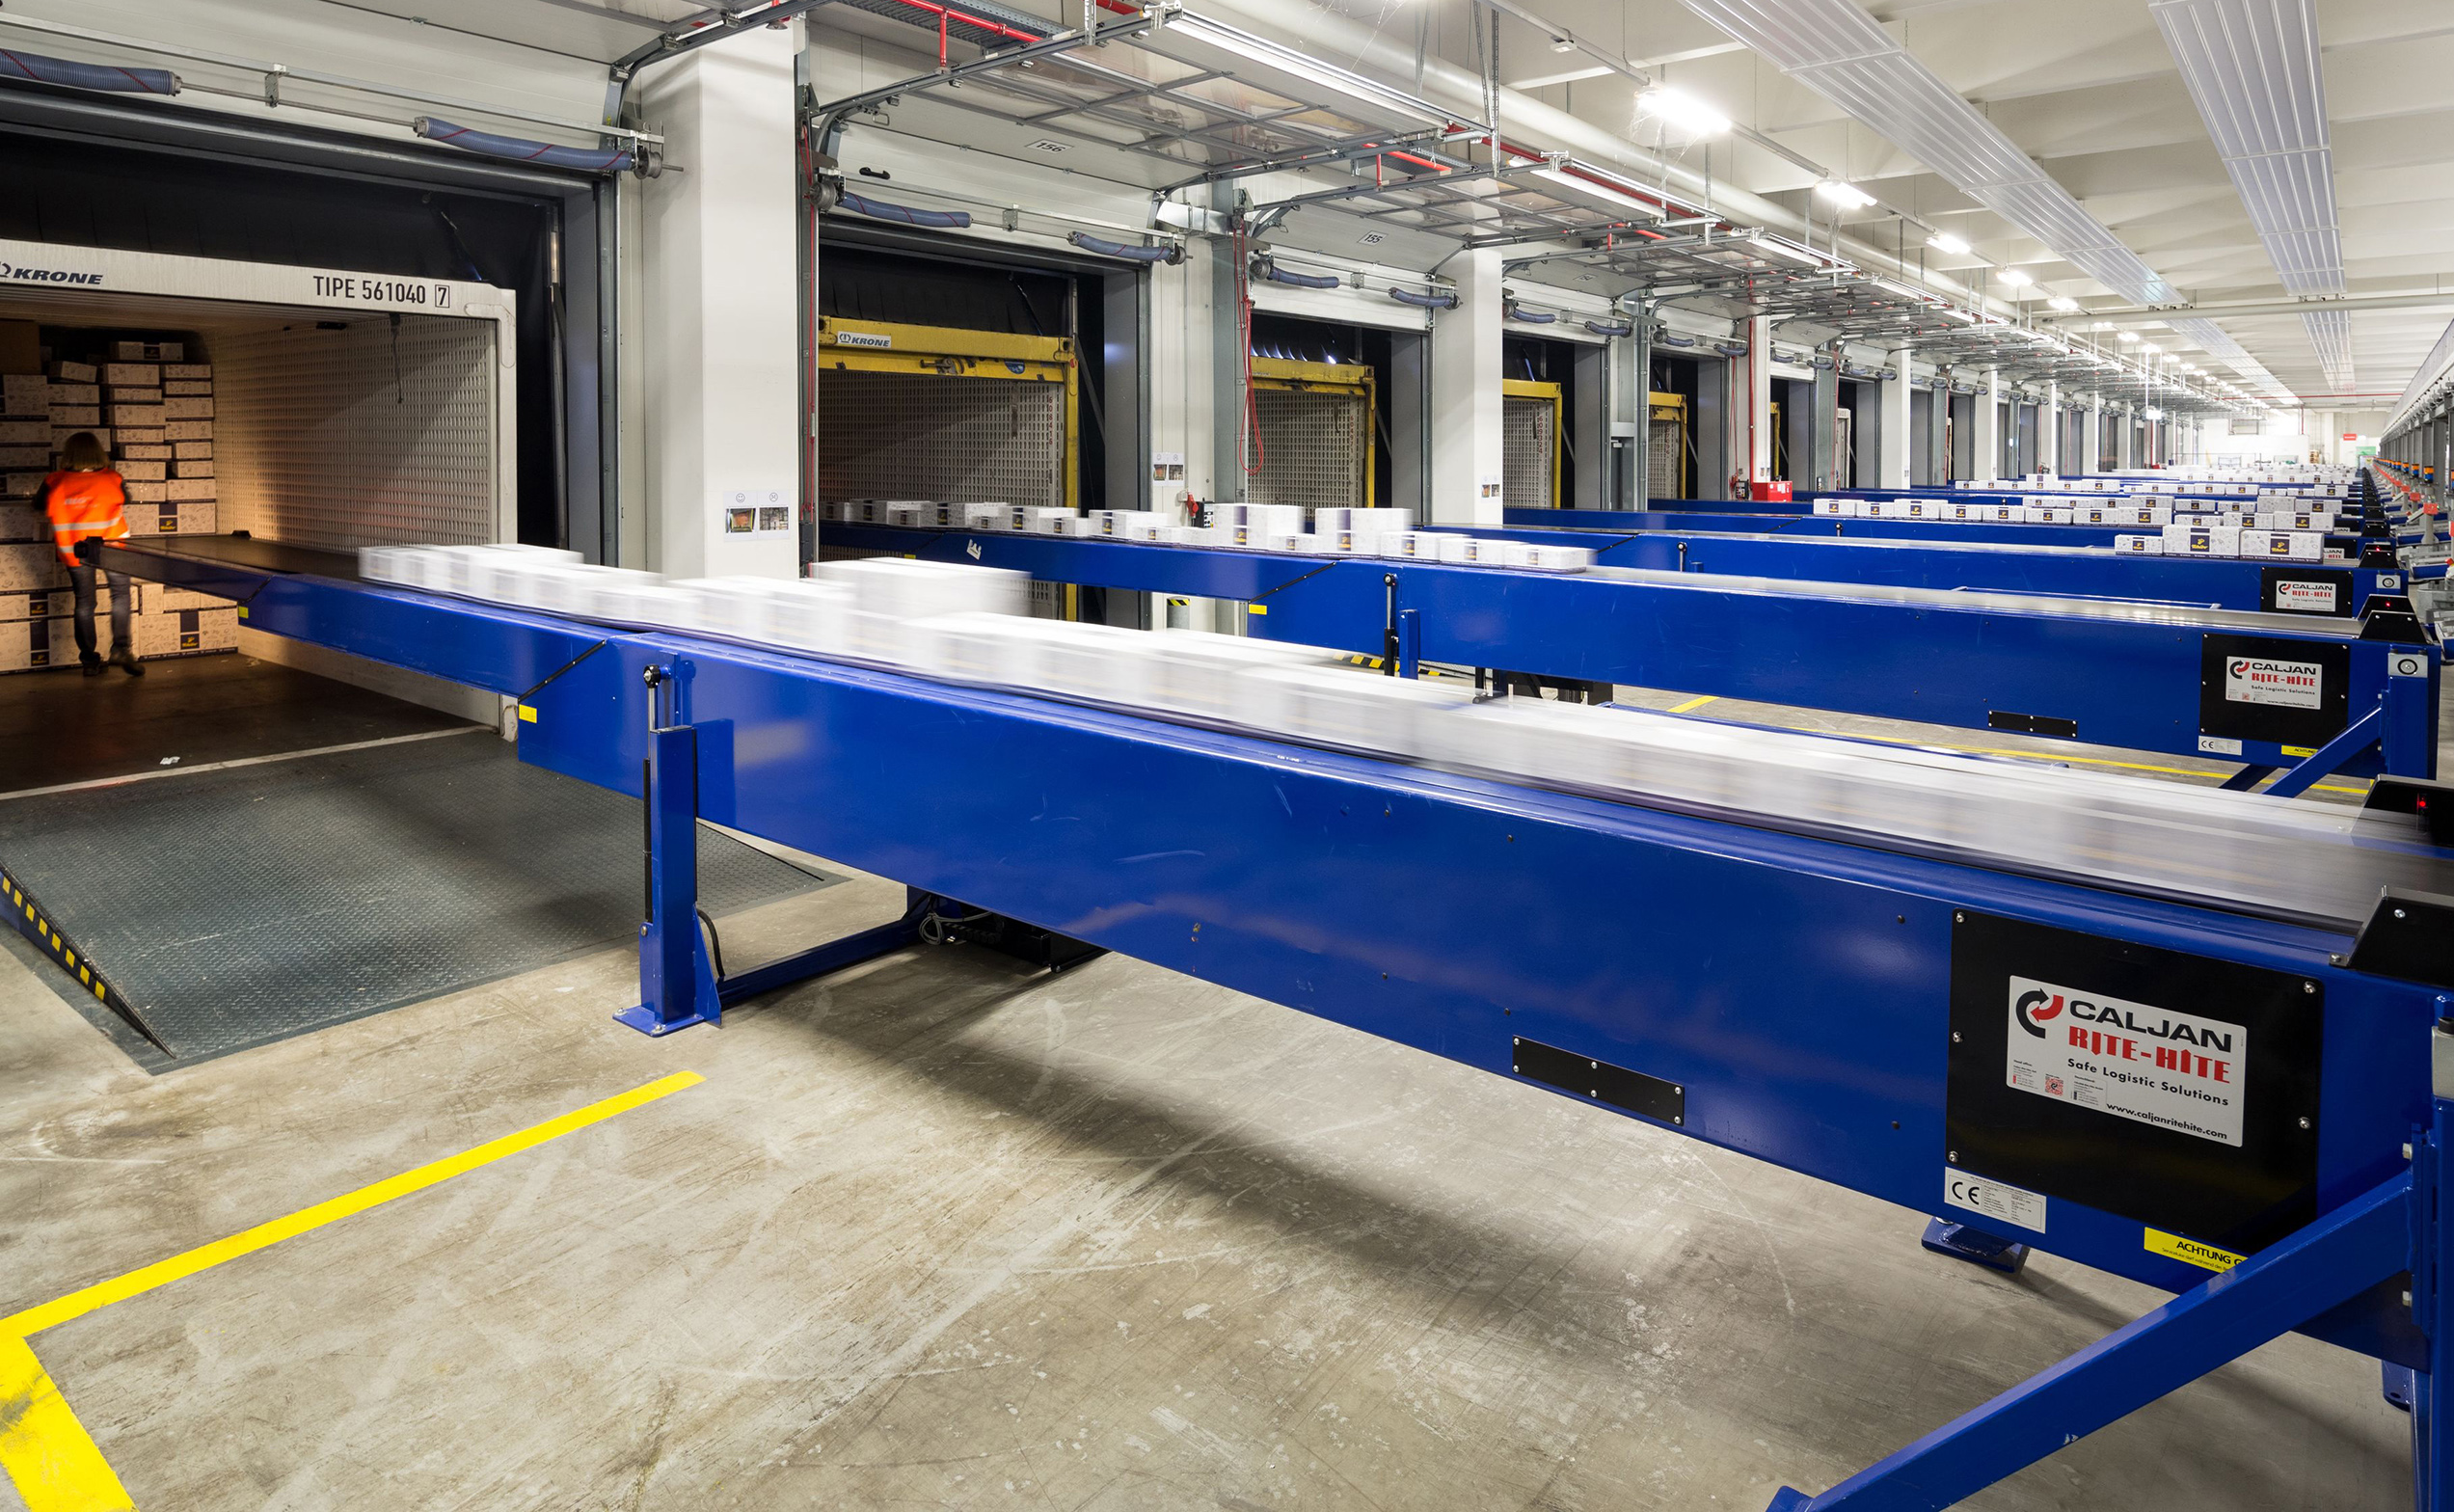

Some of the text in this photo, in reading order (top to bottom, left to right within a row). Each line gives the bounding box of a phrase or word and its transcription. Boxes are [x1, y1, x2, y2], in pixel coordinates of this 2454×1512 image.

[1036, 142, 1065, 152] 156
[13, 267, 103, 285] KRONE
[312, 275, 448, 307] TIPE 561040 7
[850, 337, 891, 347] KRONE
[2252, 662, 2316, 675] CALJAN
[2252, 672, 2316, 687] RITE-HITE
[2069, 1000, 2231, 1053] CALJAN
[2068, 1025, 2230, 1084] RITE-HITE
[2067, 1058, 2229, 1106] Safe Logistic Solutions
[2106, 1102, 2227, 1140] www.caljanritehite.com
[1952, 1181, 1980, 1205] CE
[2176, 1241, 2231, 1265] ACHTUNG
